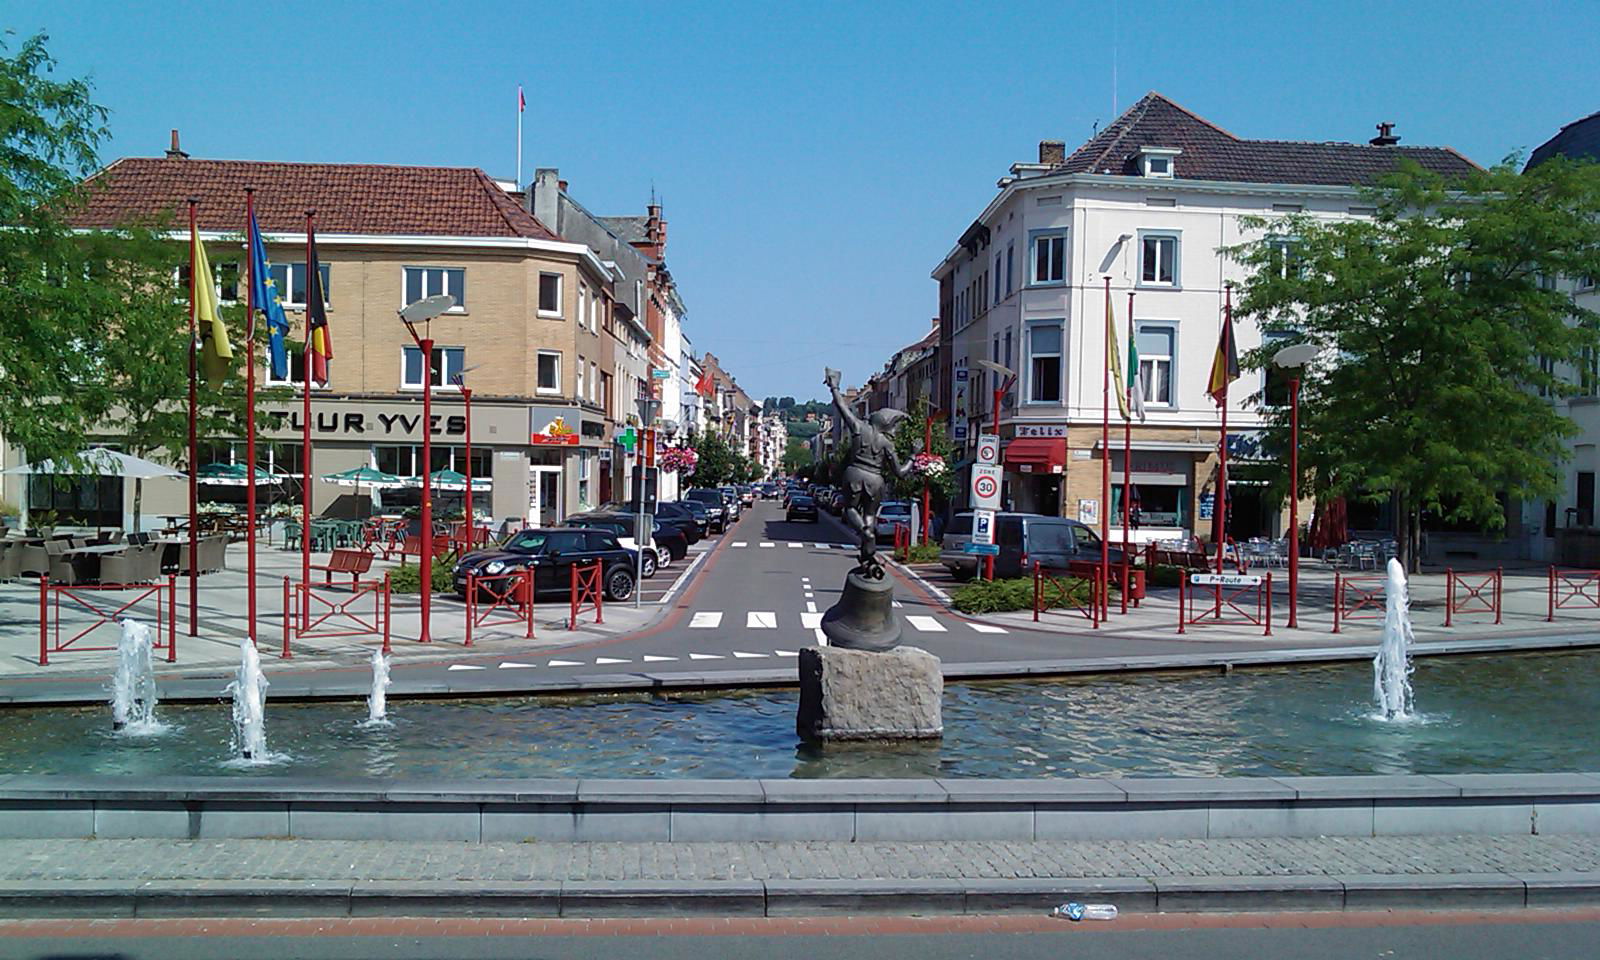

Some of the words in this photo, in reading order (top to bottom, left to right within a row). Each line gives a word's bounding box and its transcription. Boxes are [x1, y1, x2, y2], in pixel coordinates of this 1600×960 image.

[378, 413, 466, 435] YVES
[1018, 426, 1064, 436] Felix
[979, 482, 993, 492] 30
[1209, 575, 1242, 584] P-Route
